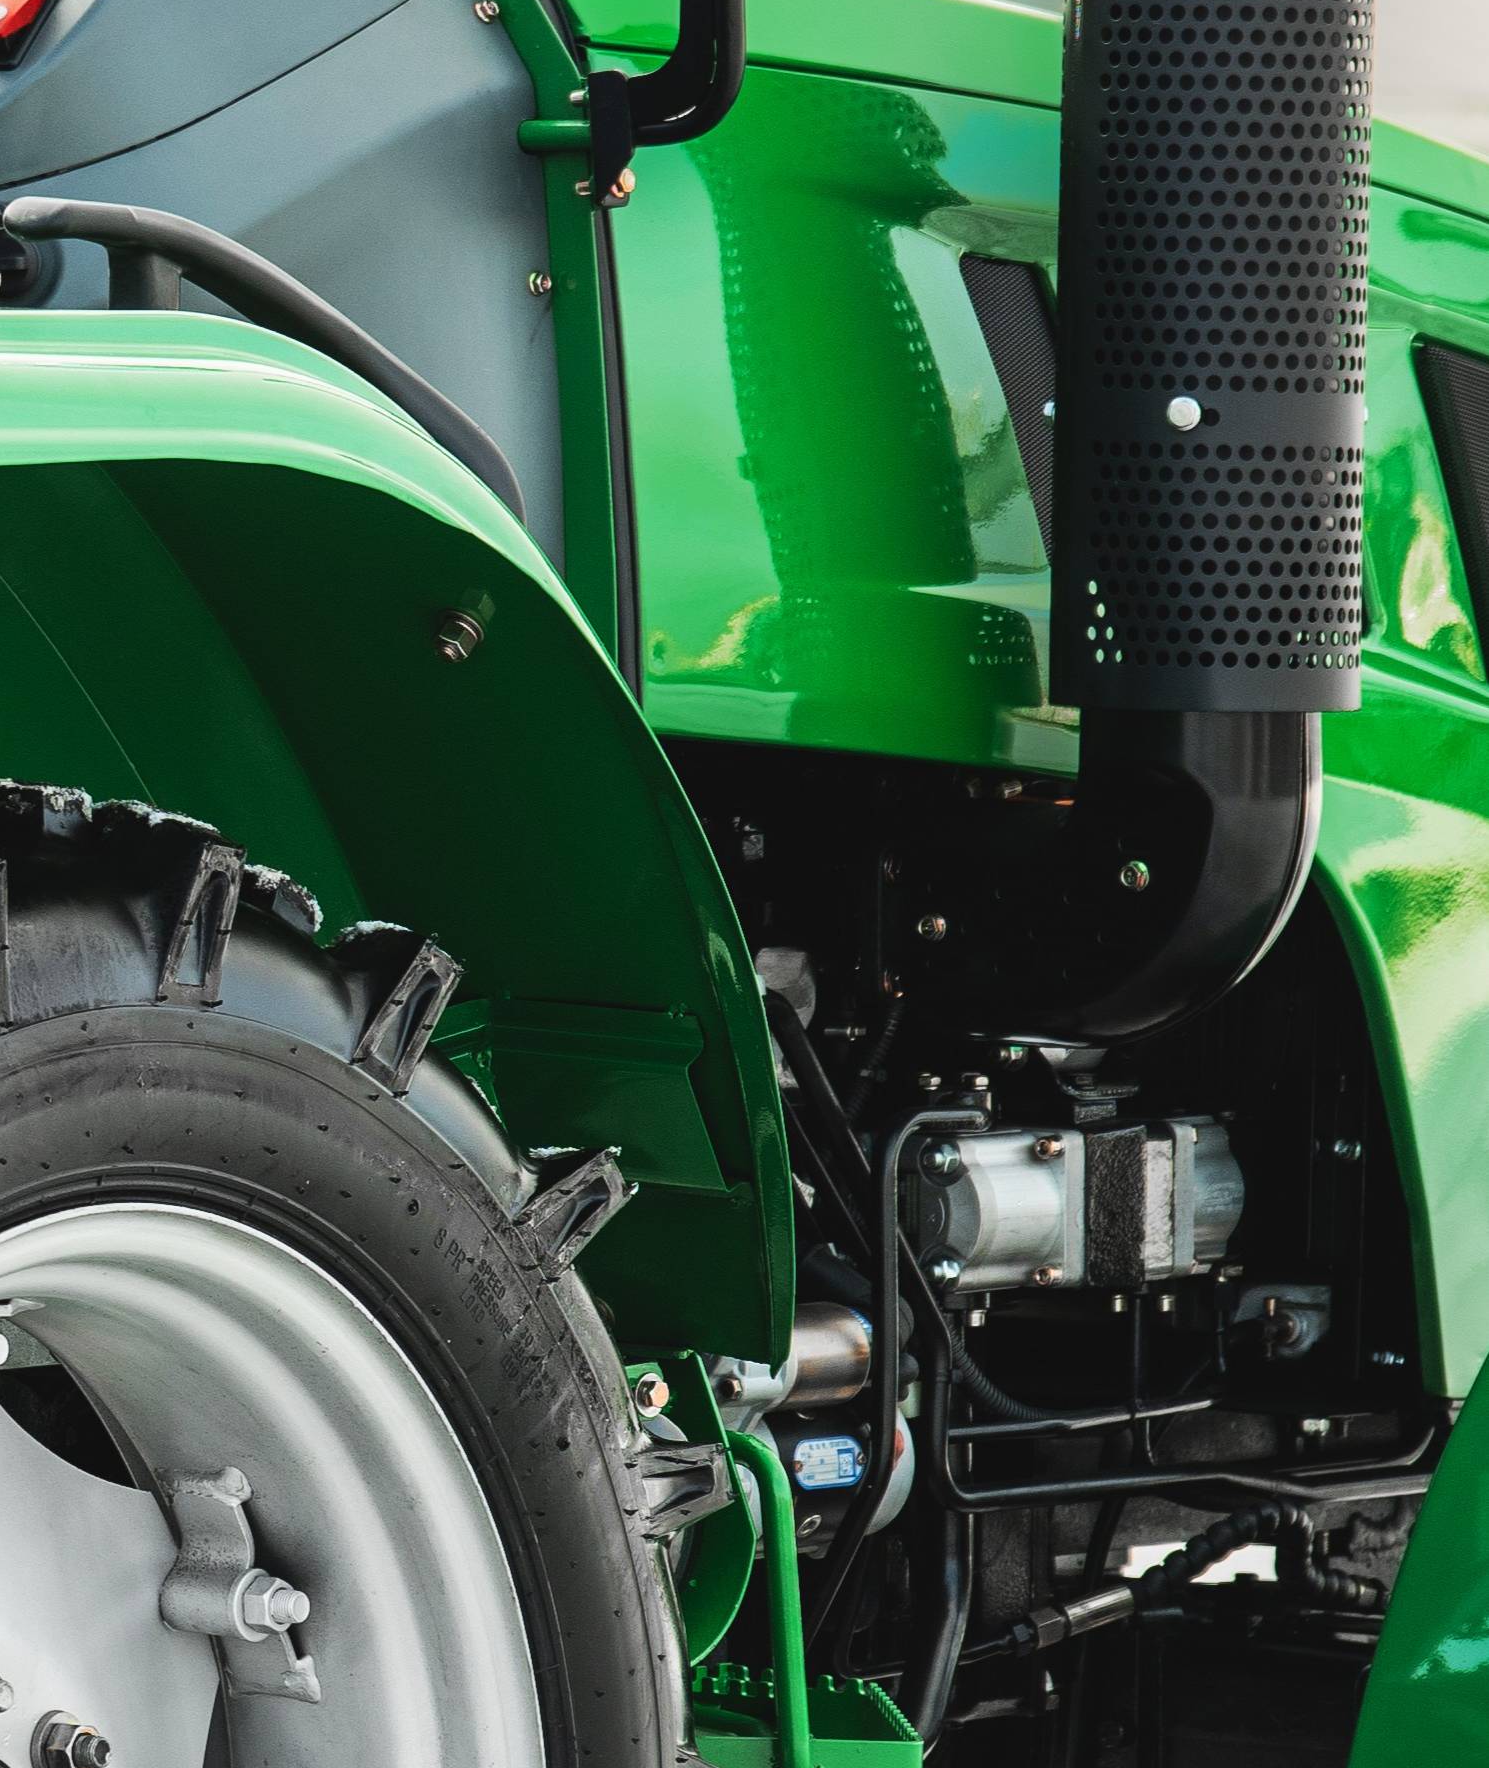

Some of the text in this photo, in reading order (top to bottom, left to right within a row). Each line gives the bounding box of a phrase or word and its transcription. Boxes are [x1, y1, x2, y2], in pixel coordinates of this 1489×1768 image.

[477, 1258, 507, 1301] SPEED
[459, 1288, 486, 1324] LOAD
[468, 1272, 513, 1340] PRESSURE
